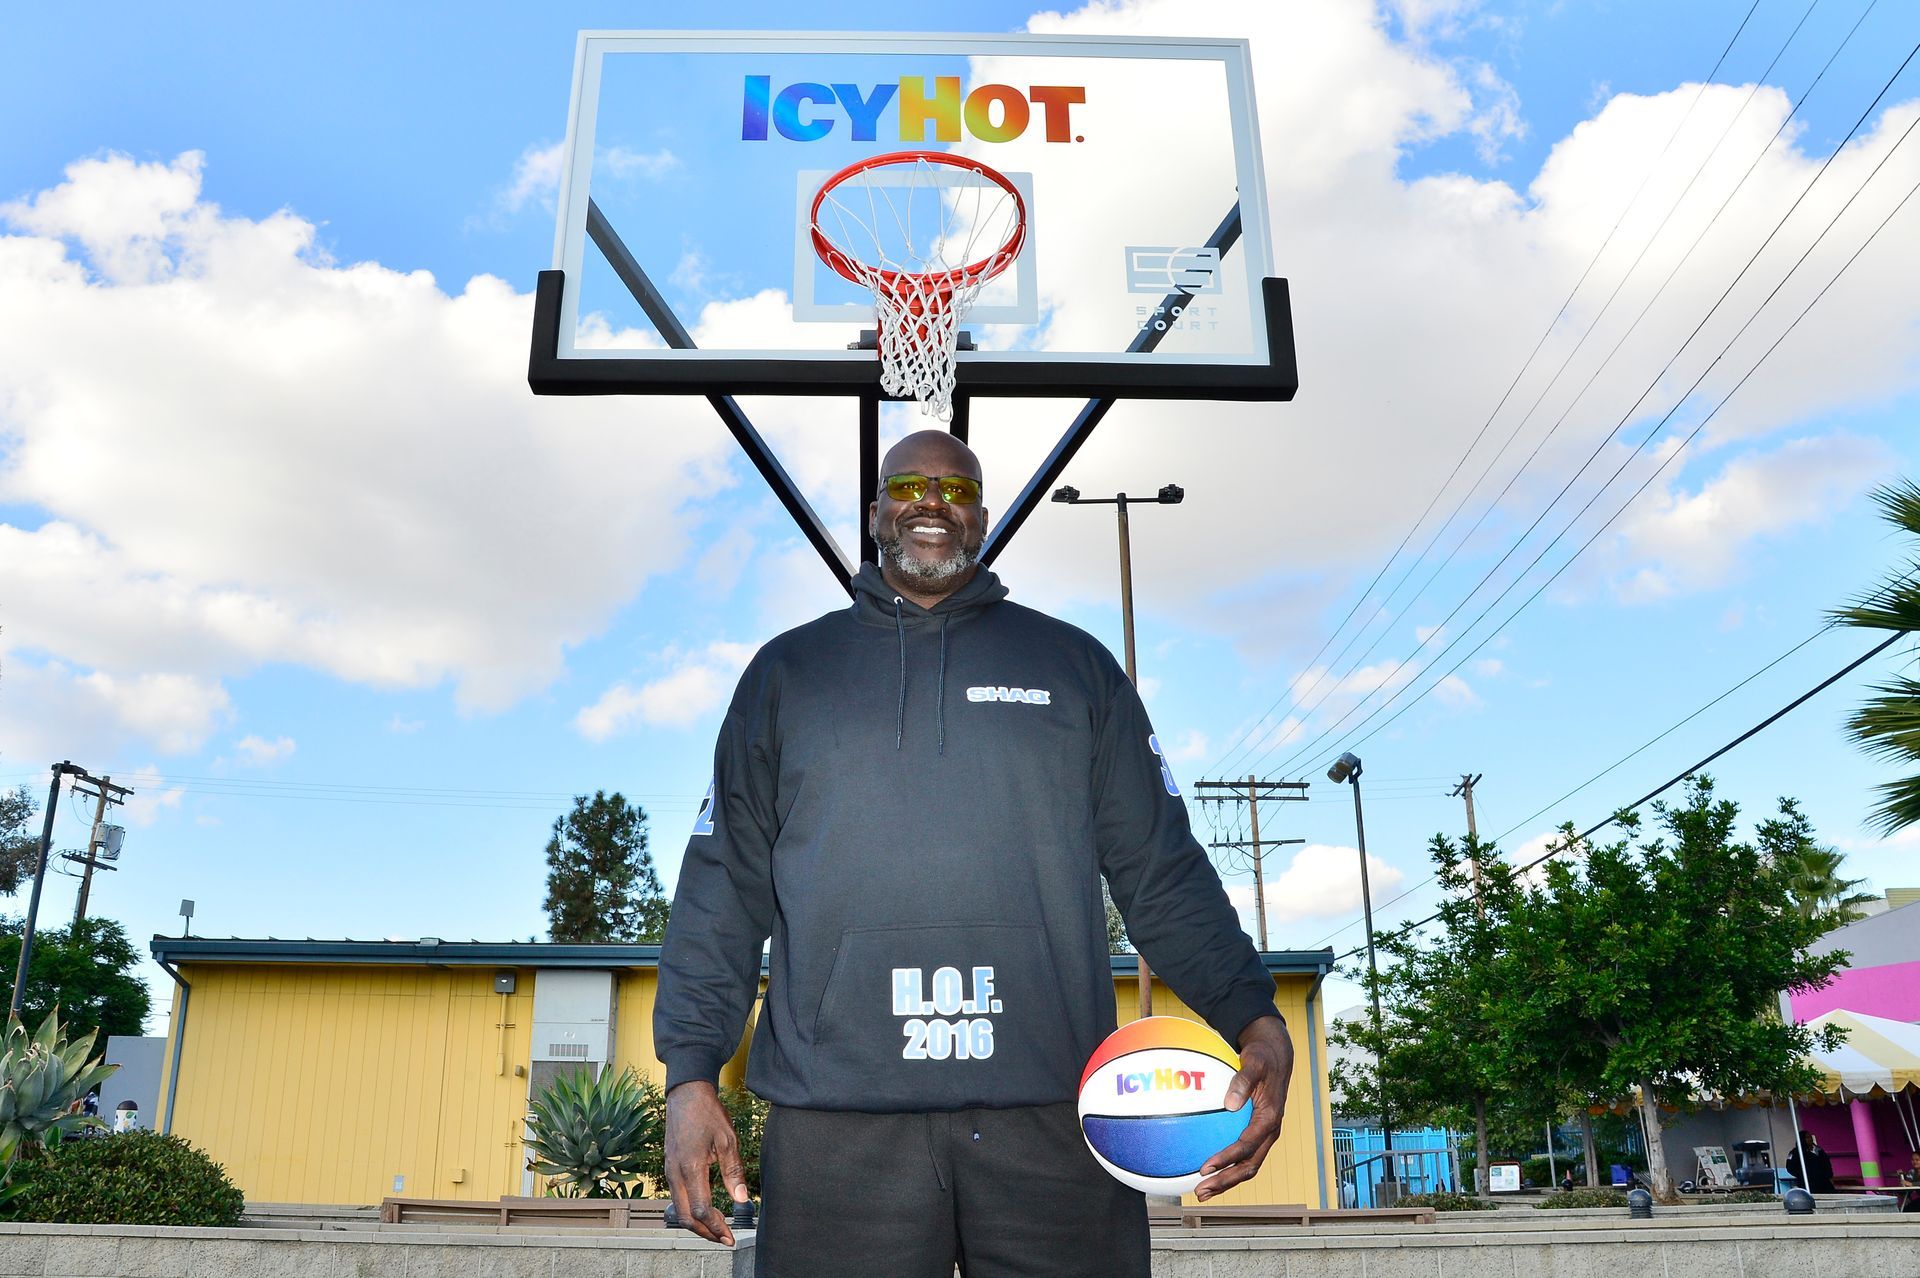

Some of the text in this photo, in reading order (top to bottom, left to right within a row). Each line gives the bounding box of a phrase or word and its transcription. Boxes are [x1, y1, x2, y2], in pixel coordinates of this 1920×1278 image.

[1135, 305, 1218, 317] SPORT
[1137, 319, 1219, 331] COURT
[966, 686, 1051, 705] SHAQ
[892, 966, 1003, 1016] H.O.F.
[902, 1018, 995, 1060] 2016
